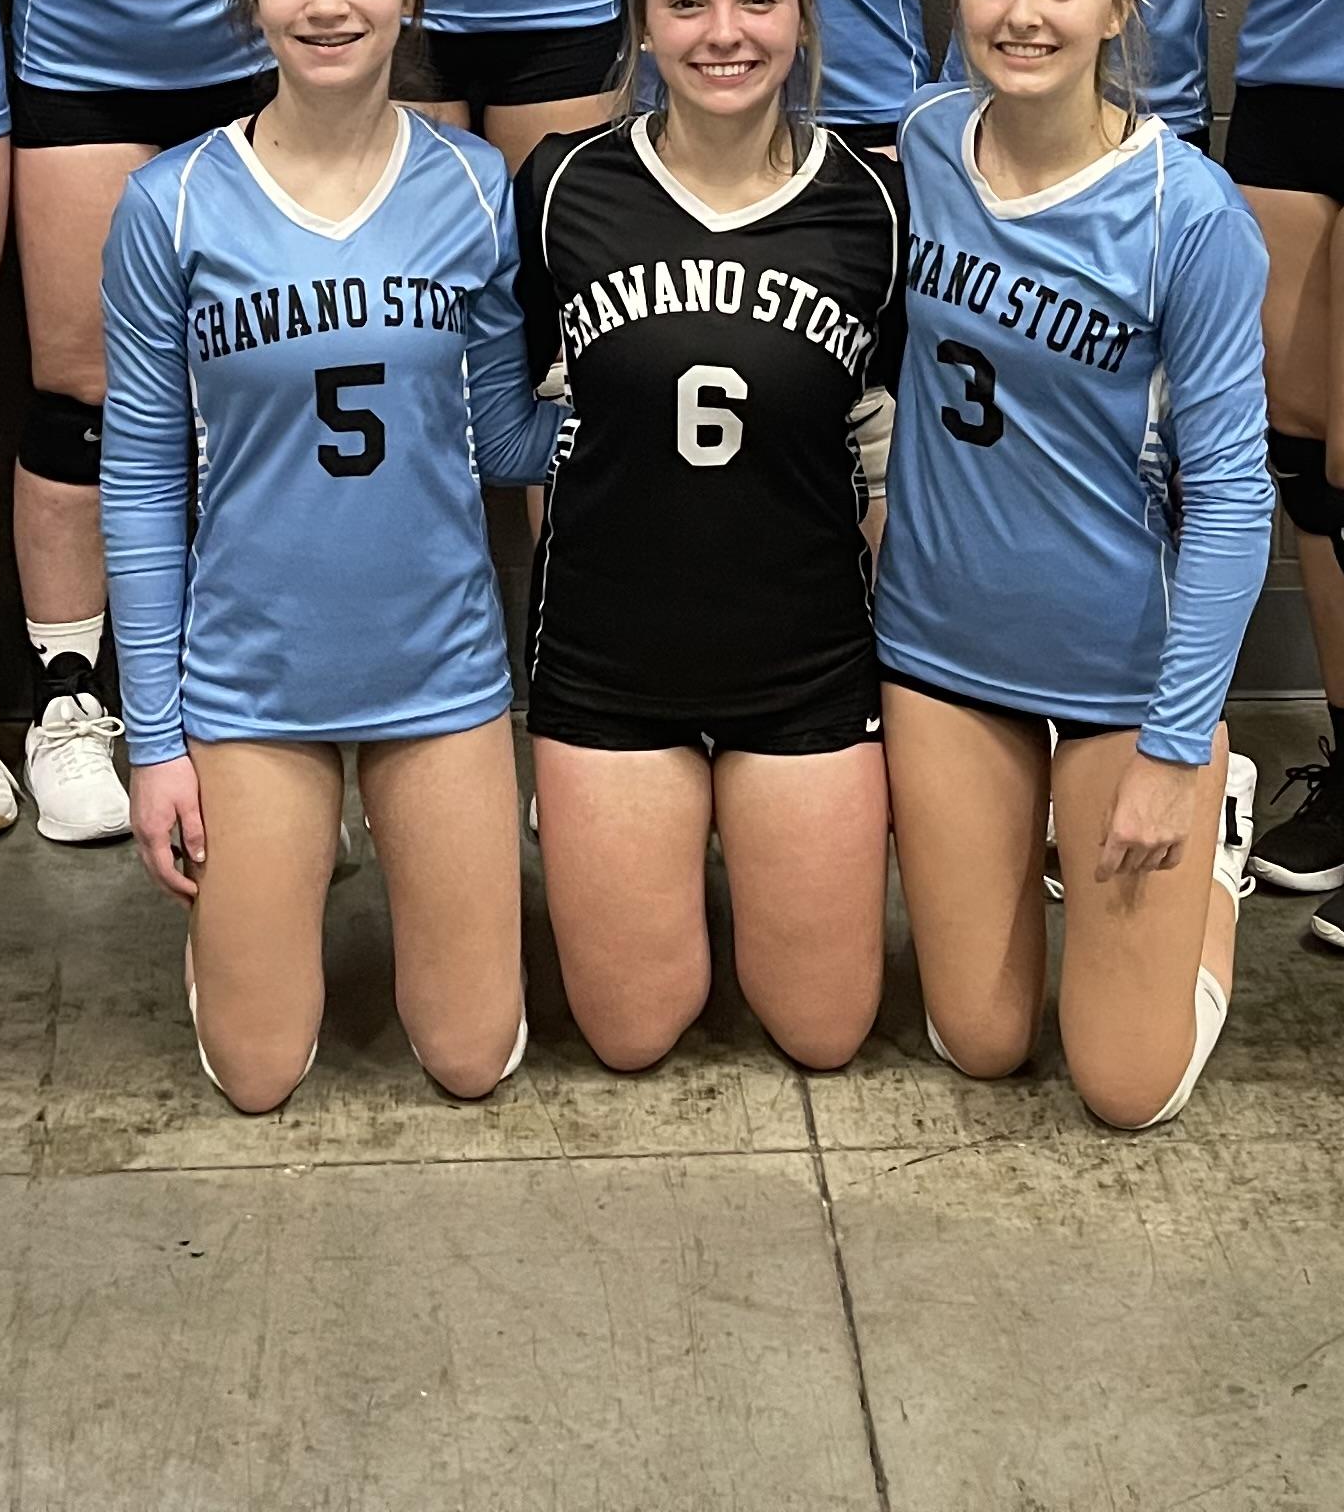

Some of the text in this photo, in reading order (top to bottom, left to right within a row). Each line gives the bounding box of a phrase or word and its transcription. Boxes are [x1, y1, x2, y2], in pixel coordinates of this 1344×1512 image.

[193, 275, 466, 362] SHAWANO STOR
[998, 276, 1143, 374] STORM
[314, 362, 386, 478] 5
[677, 364, 749, 467] 6
[936, 338, 1005, 448] 3
